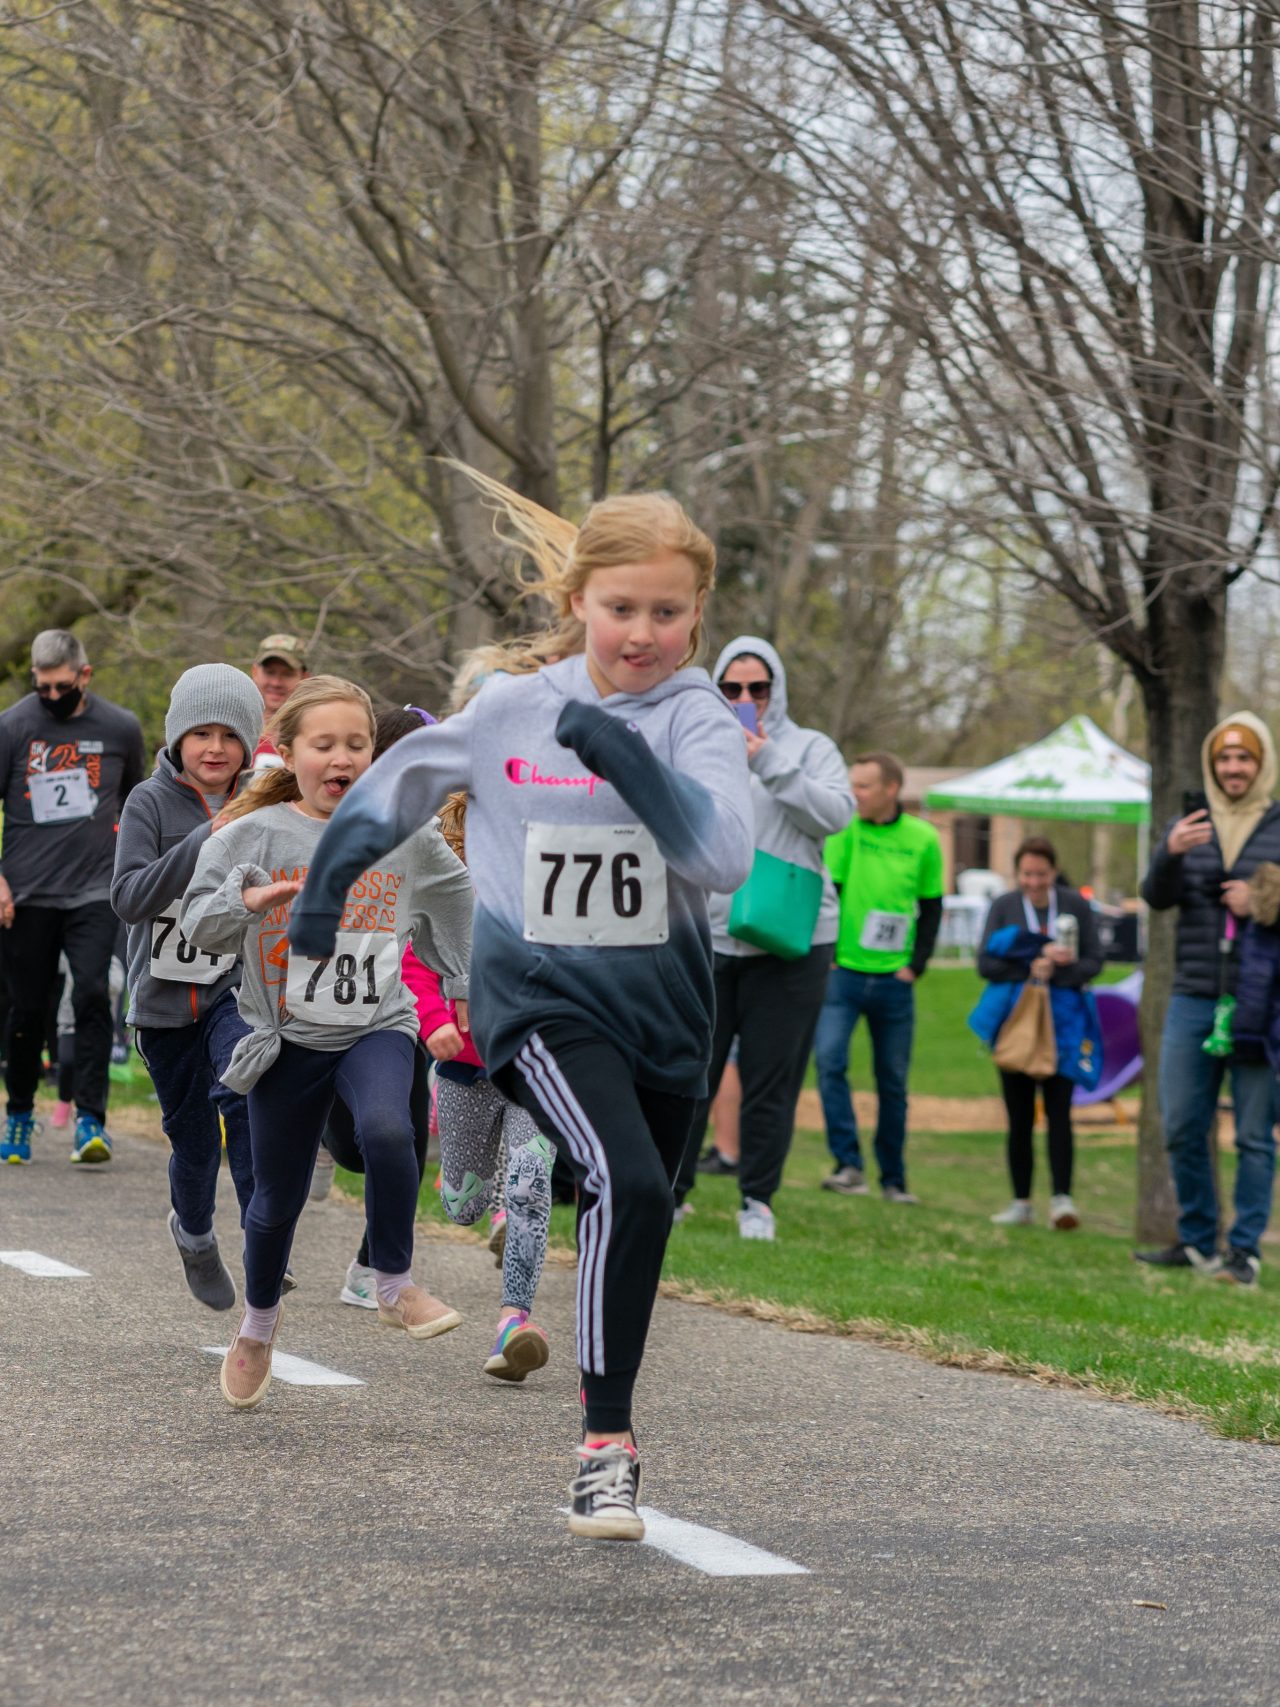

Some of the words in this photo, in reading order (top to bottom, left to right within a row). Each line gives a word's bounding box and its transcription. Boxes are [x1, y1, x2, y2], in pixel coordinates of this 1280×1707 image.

[53, 784, 70, 807] 2
[540, 852, 642, 918] 776
[304, 954, 381, 1005] 781
